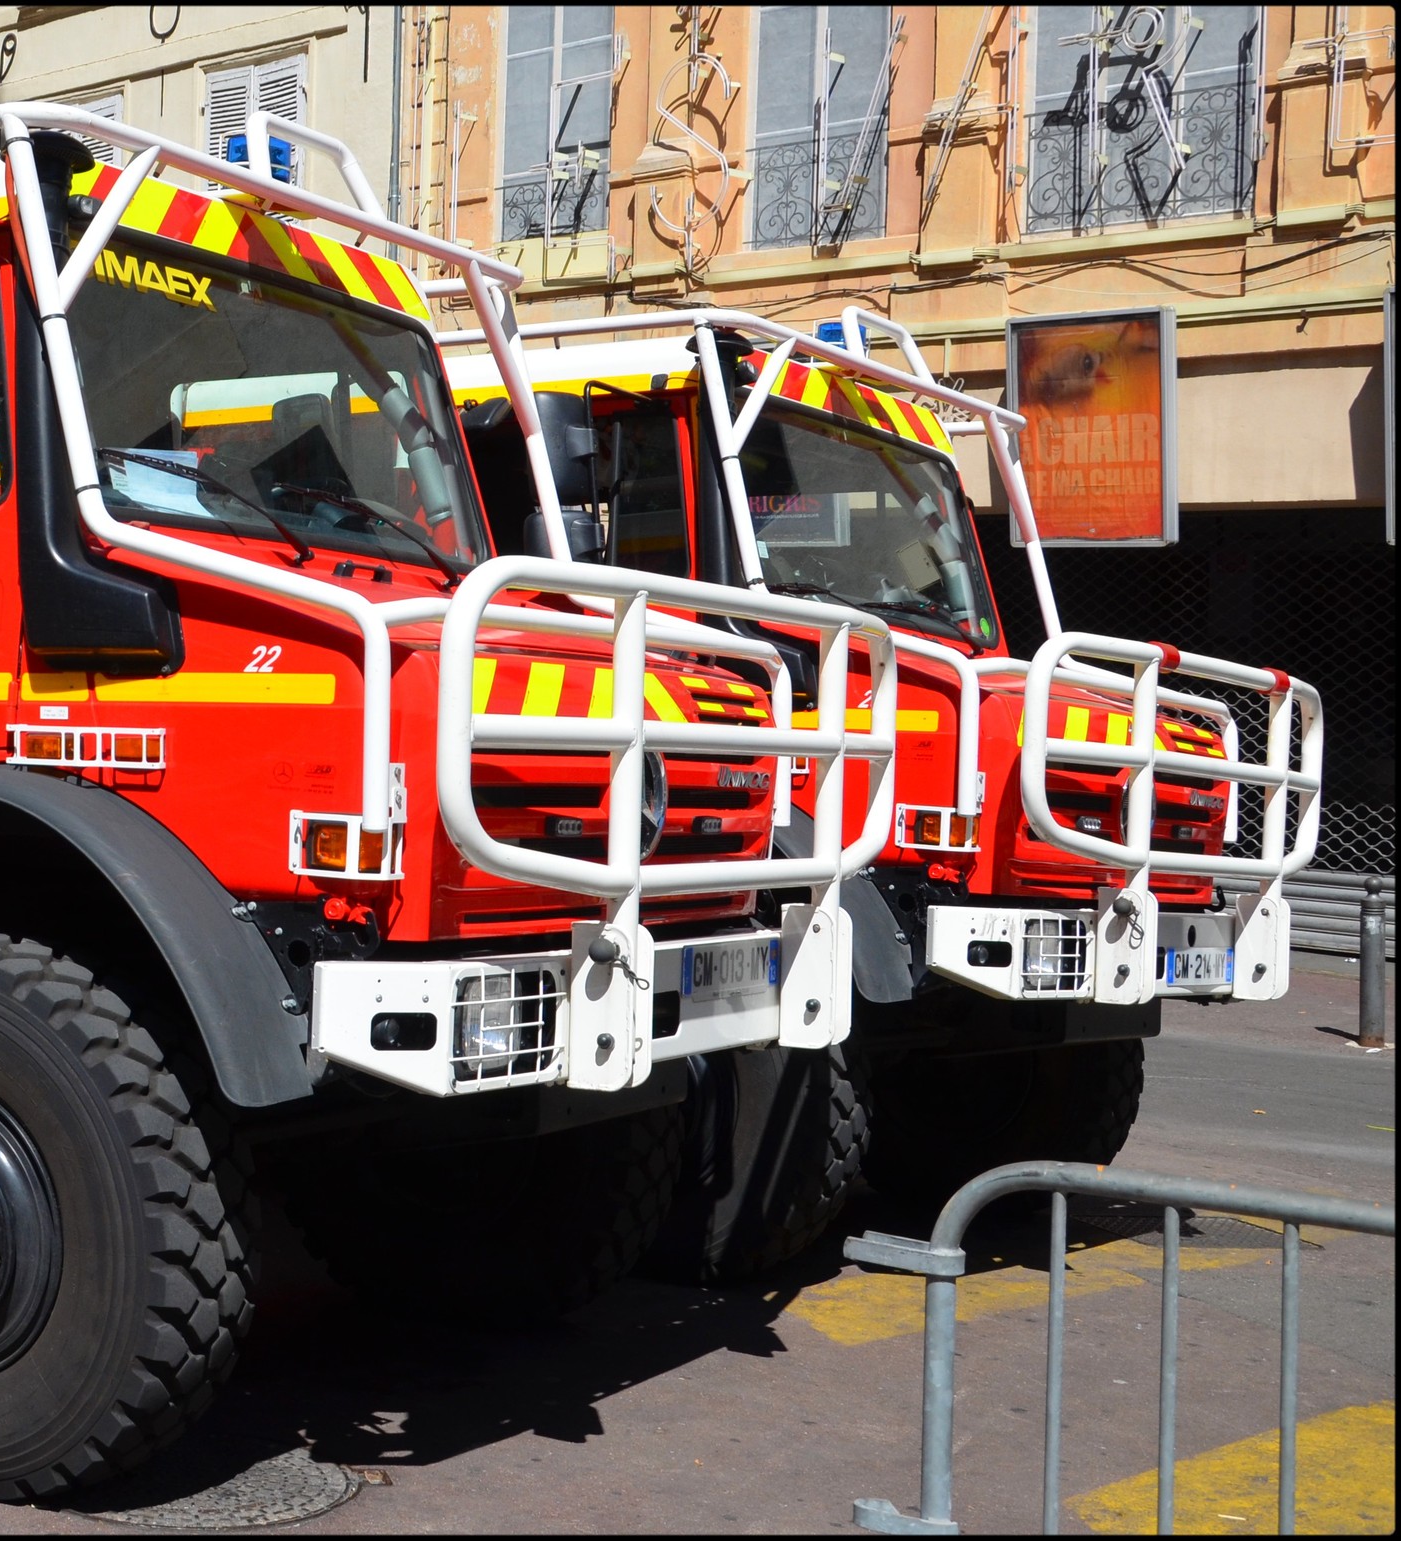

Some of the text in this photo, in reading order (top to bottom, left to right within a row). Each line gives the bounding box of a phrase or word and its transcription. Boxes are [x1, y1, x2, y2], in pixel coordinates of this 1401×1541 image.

[94, 248, 212, 306] IMAEX
[1036, 413, 1159, 465] CHAIR
[1052, 469, 1087, 497] MA
[1089, 467, 1160, 496] CHAIR
[749, 495, 822, 513] RIGRIS
[243, 645, 283, 673] 22
